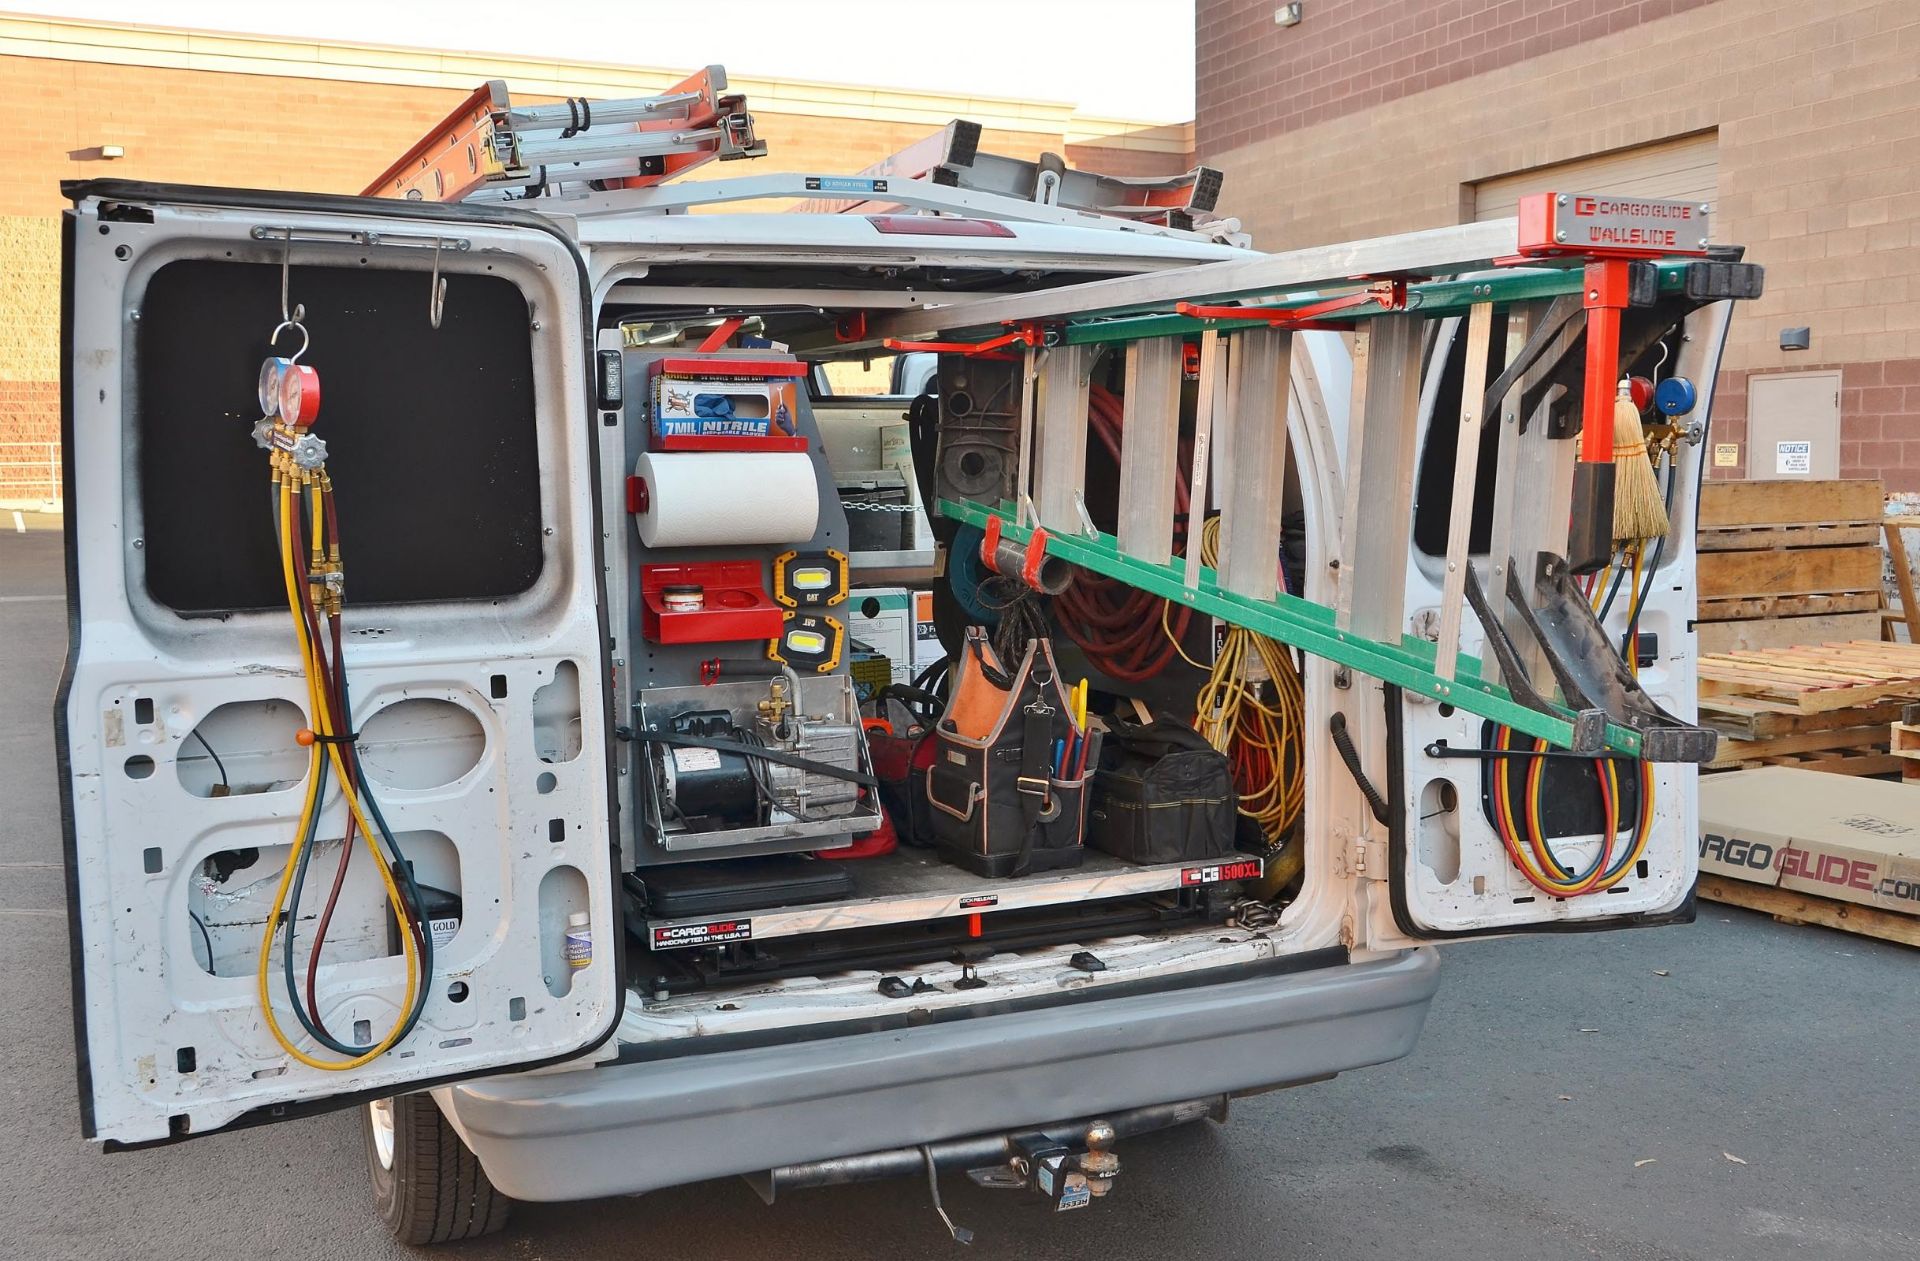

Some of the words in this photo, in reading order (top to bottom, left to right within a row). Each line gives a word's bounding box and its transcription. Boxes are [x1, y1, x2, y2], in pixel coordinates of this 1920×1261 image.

[1590, 226, 1677, 246] WALLSLIDE
[703, 421, 768, 433] NITRILE
[1779, 444, 1808, 453] NOTICE
[807, 594, 819, 602] CAT
[802, 618, 816, 627] CAT
[433, 921, 455, 931] GOLD
[656, 937, 703, 947] HANDCRAFTED
